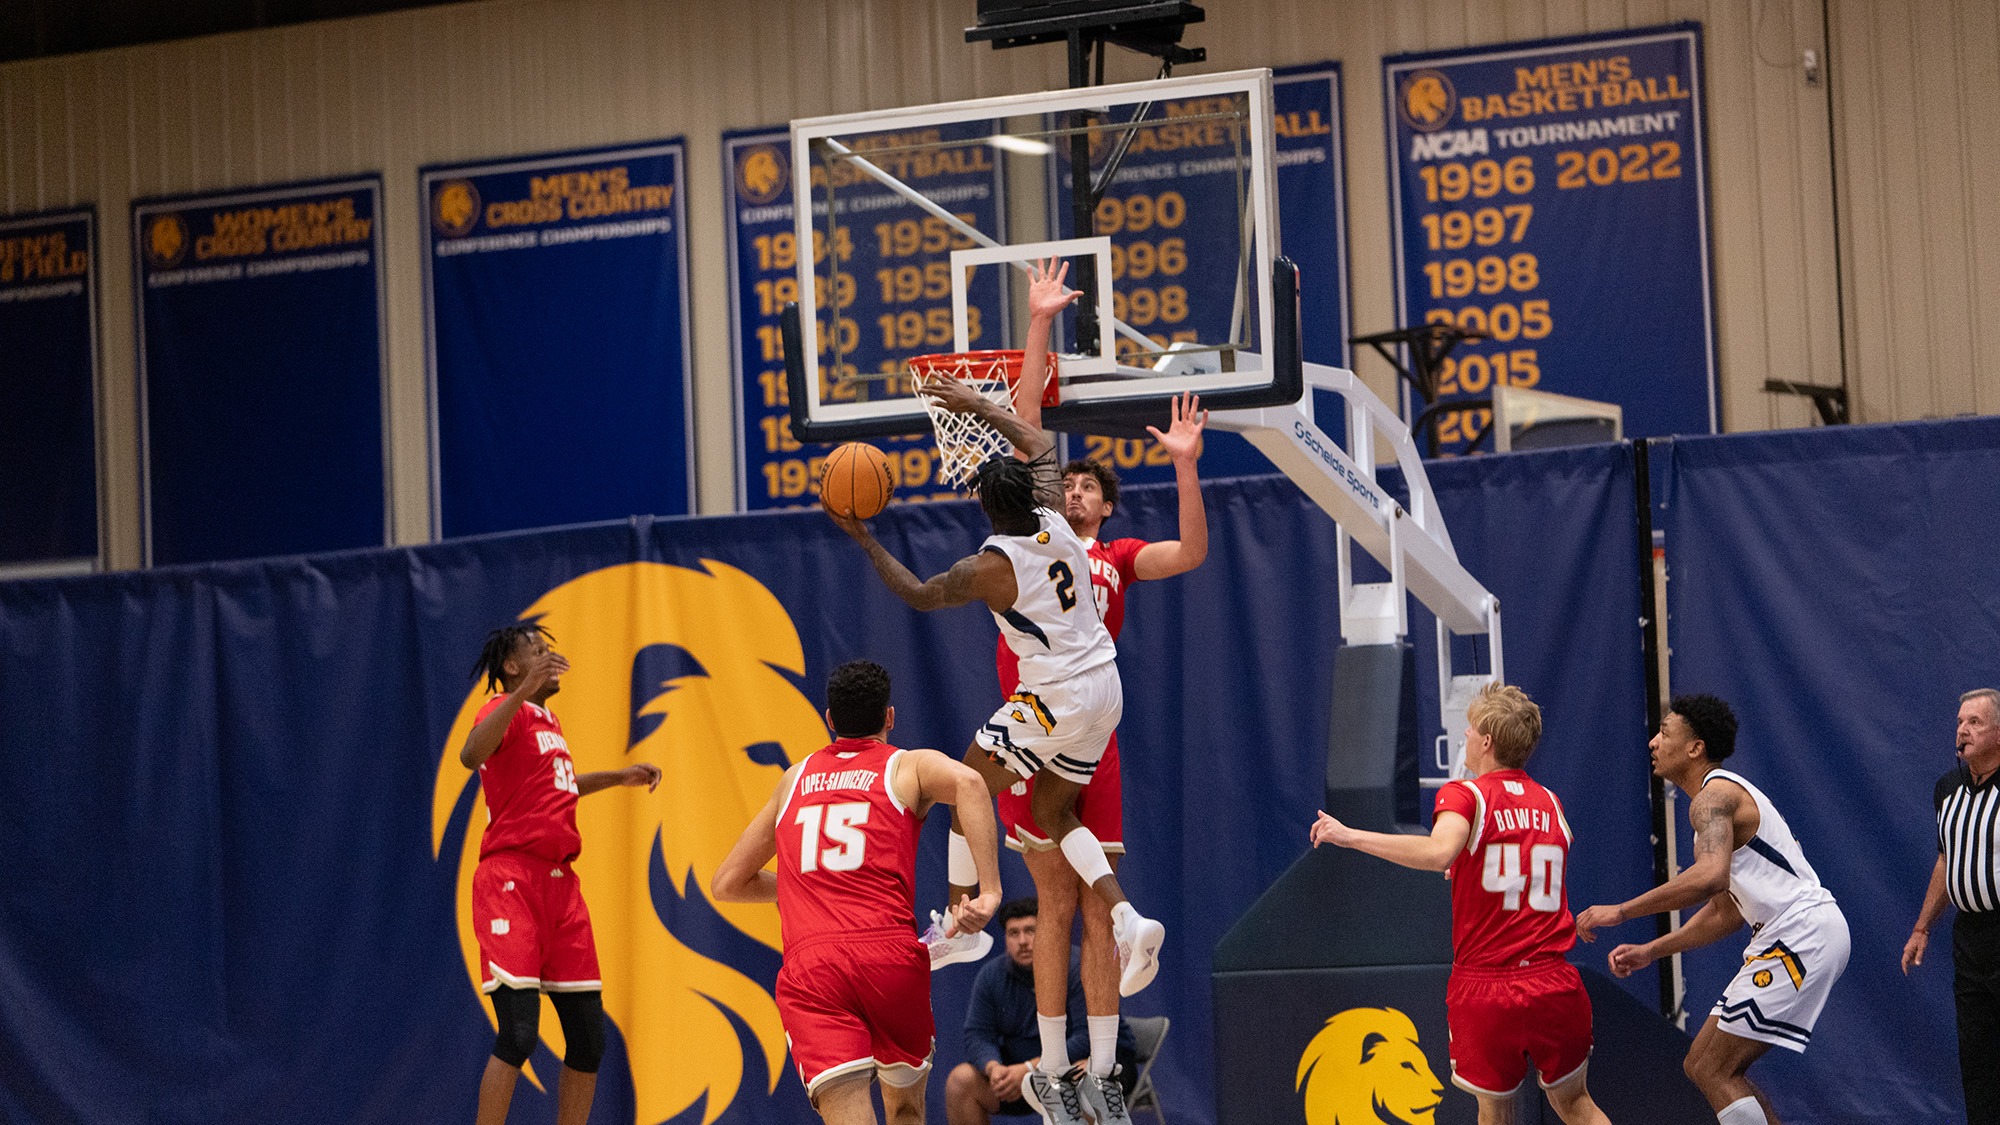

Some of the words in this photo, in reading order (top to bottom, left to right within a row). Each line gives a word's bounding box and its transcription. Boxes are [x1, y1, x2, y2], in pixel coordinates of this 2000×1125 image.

[1460, 75, 1690, 121] BASKETBALL
[1515, 56, 1632, 94] MEN'S
[1411, 128, 1490, 161] NCAA
[1493, 111, 1681, 148] TOURNAMENT
[530, 166, 629, 202] MEN'S
[1420, 157, 1536, 201] 1996
[1556, 142, 1682, 190] 2022
[567, 185, 674, 219] COUNTRY
[1422, 204, 1534, 251] 1997
[1424, 253, 1541, 299] 1998
[1304, 431, 1345, 478] Schelde
[1346, 469, 1379, 509] Sports
[1048, 559, 1077, 613] 2
[794, 801, 871, 875] 15
[1493, 808, 1550, 833] BOWEN
[1481, 843, 1565, 912] 40
